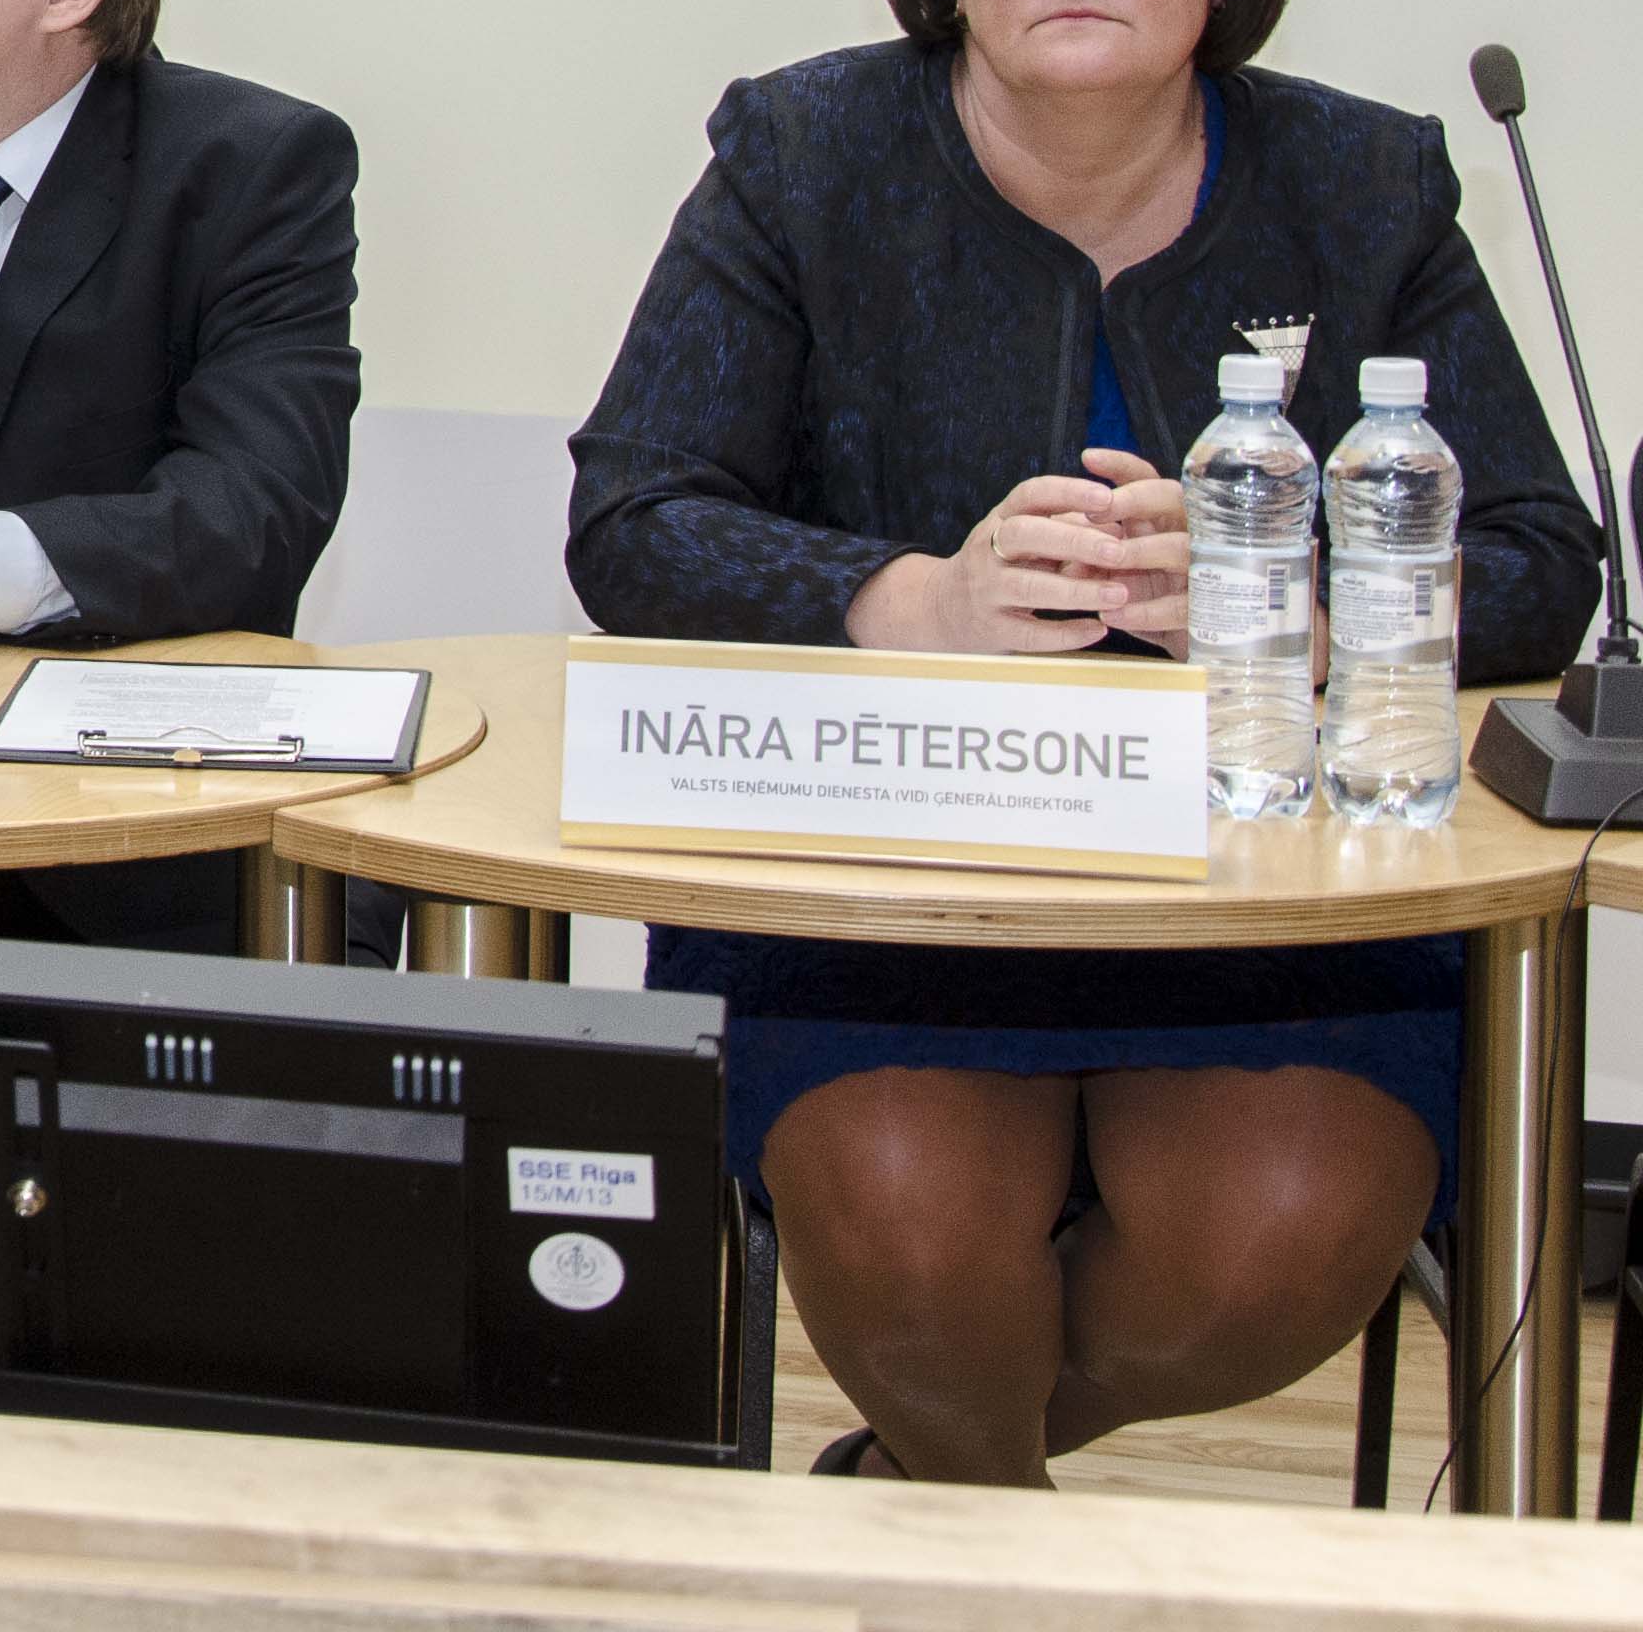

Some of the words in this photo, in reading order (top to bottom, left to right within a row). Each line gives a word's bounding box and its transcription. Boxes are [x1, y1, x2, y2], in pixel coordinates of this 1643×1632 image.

[619, 704, 794, 762] INĀRA
[814, 712, 1151, 782] PĒTERSONE
[670, 777, 728, 793] VALSTS
[732, 779, 813, 798] IEŅĒMUMU
[817, 784, 891, 801] DIENESTA
[895, 788, 929, 804] (VID)
[519, 1159, 572, 1180] SSE
[580, 1163, 637, 1186] Riga
